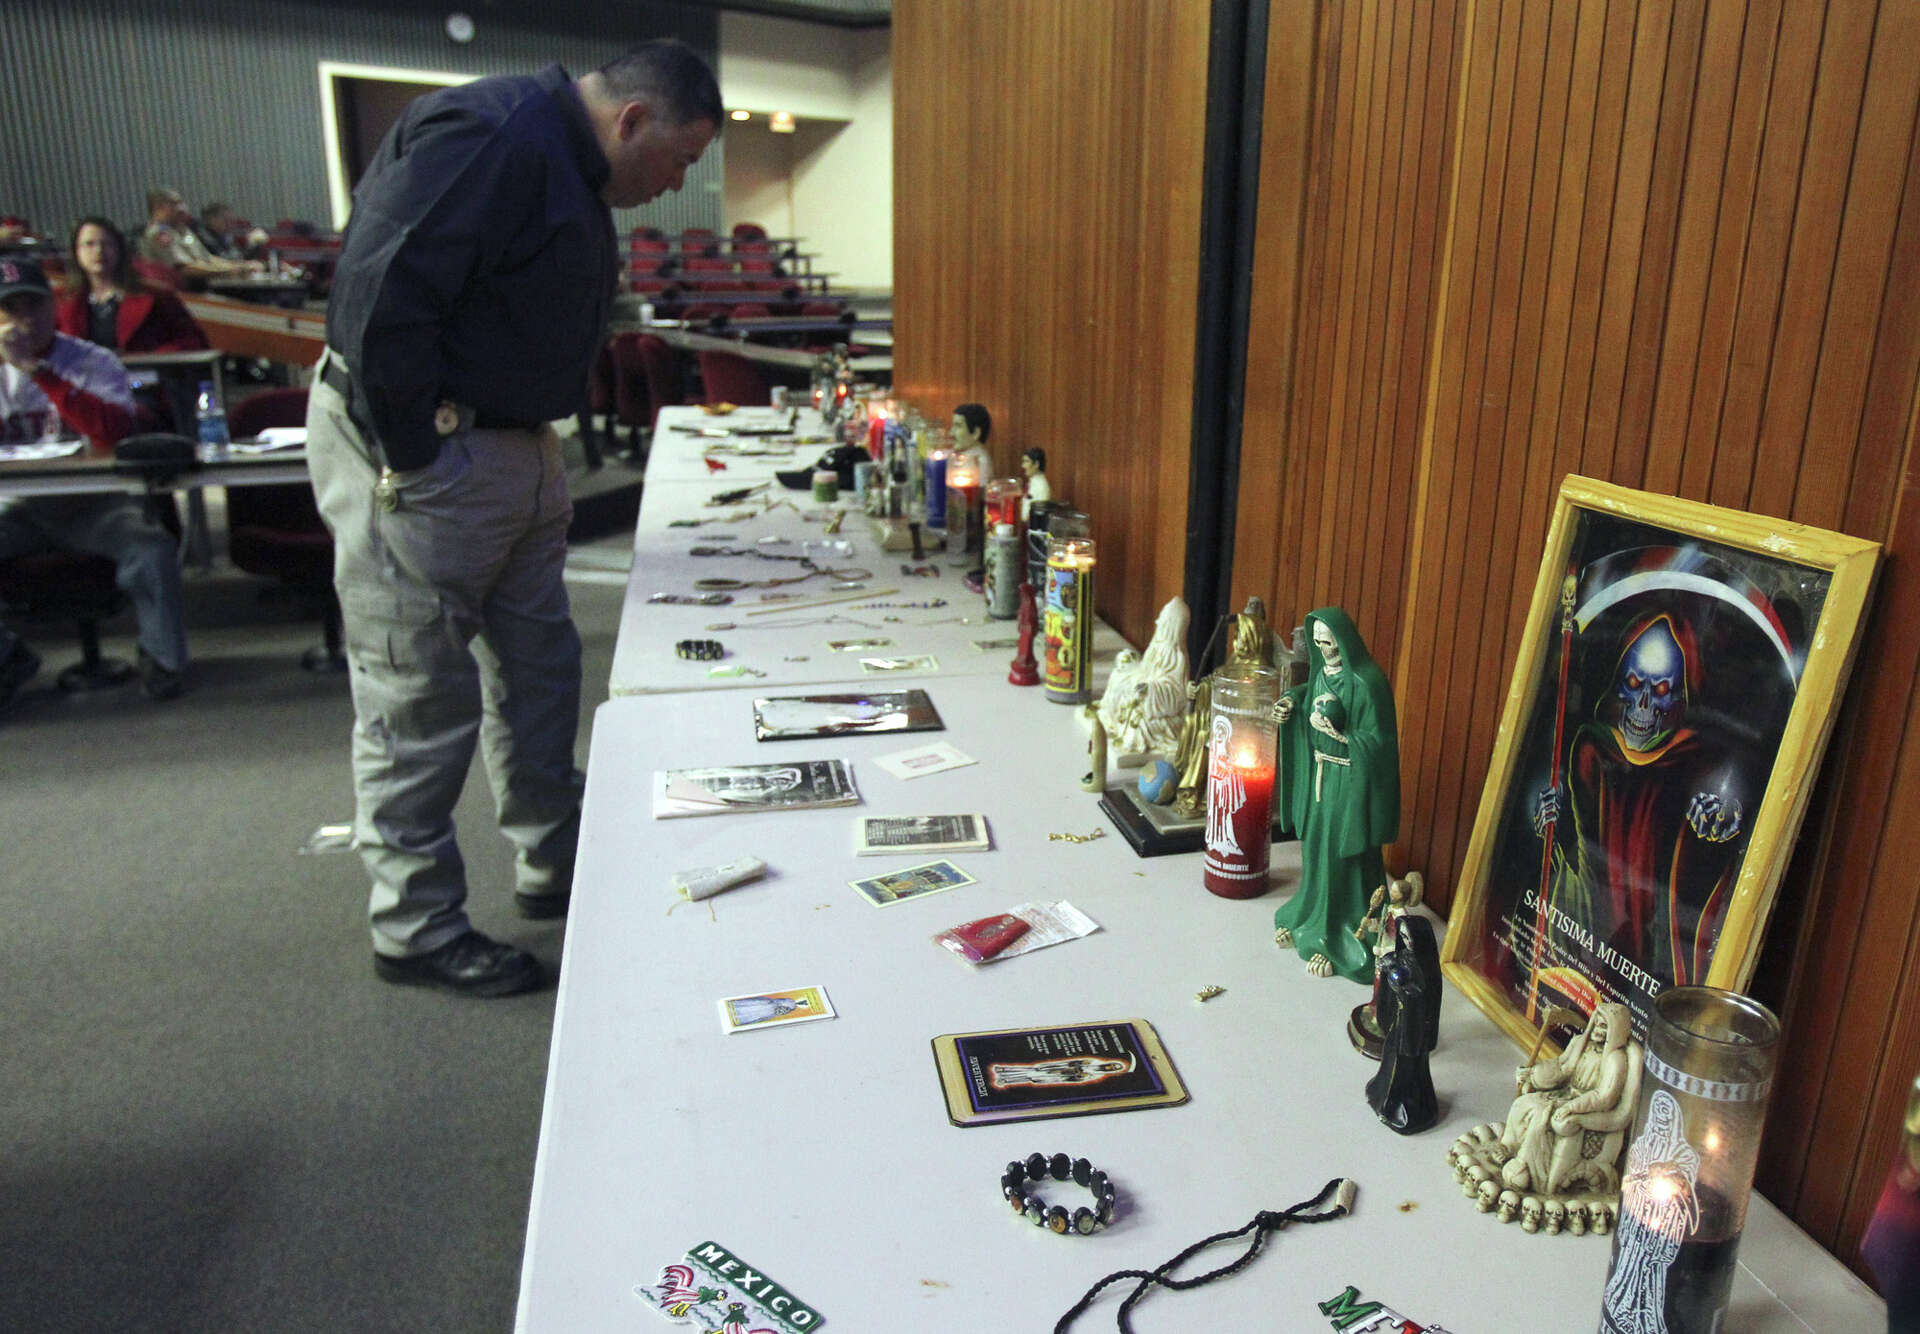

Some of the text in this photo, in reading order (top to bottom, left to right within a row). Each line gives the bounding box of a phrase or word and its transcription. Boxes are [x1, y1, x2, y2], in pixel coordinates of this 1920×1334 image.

[1523, 888, 1595, 954] SANTISIMA
[1596, 941, 1661, 999] MUERTE
[696, 1244, 813, 1327] MEXICO
